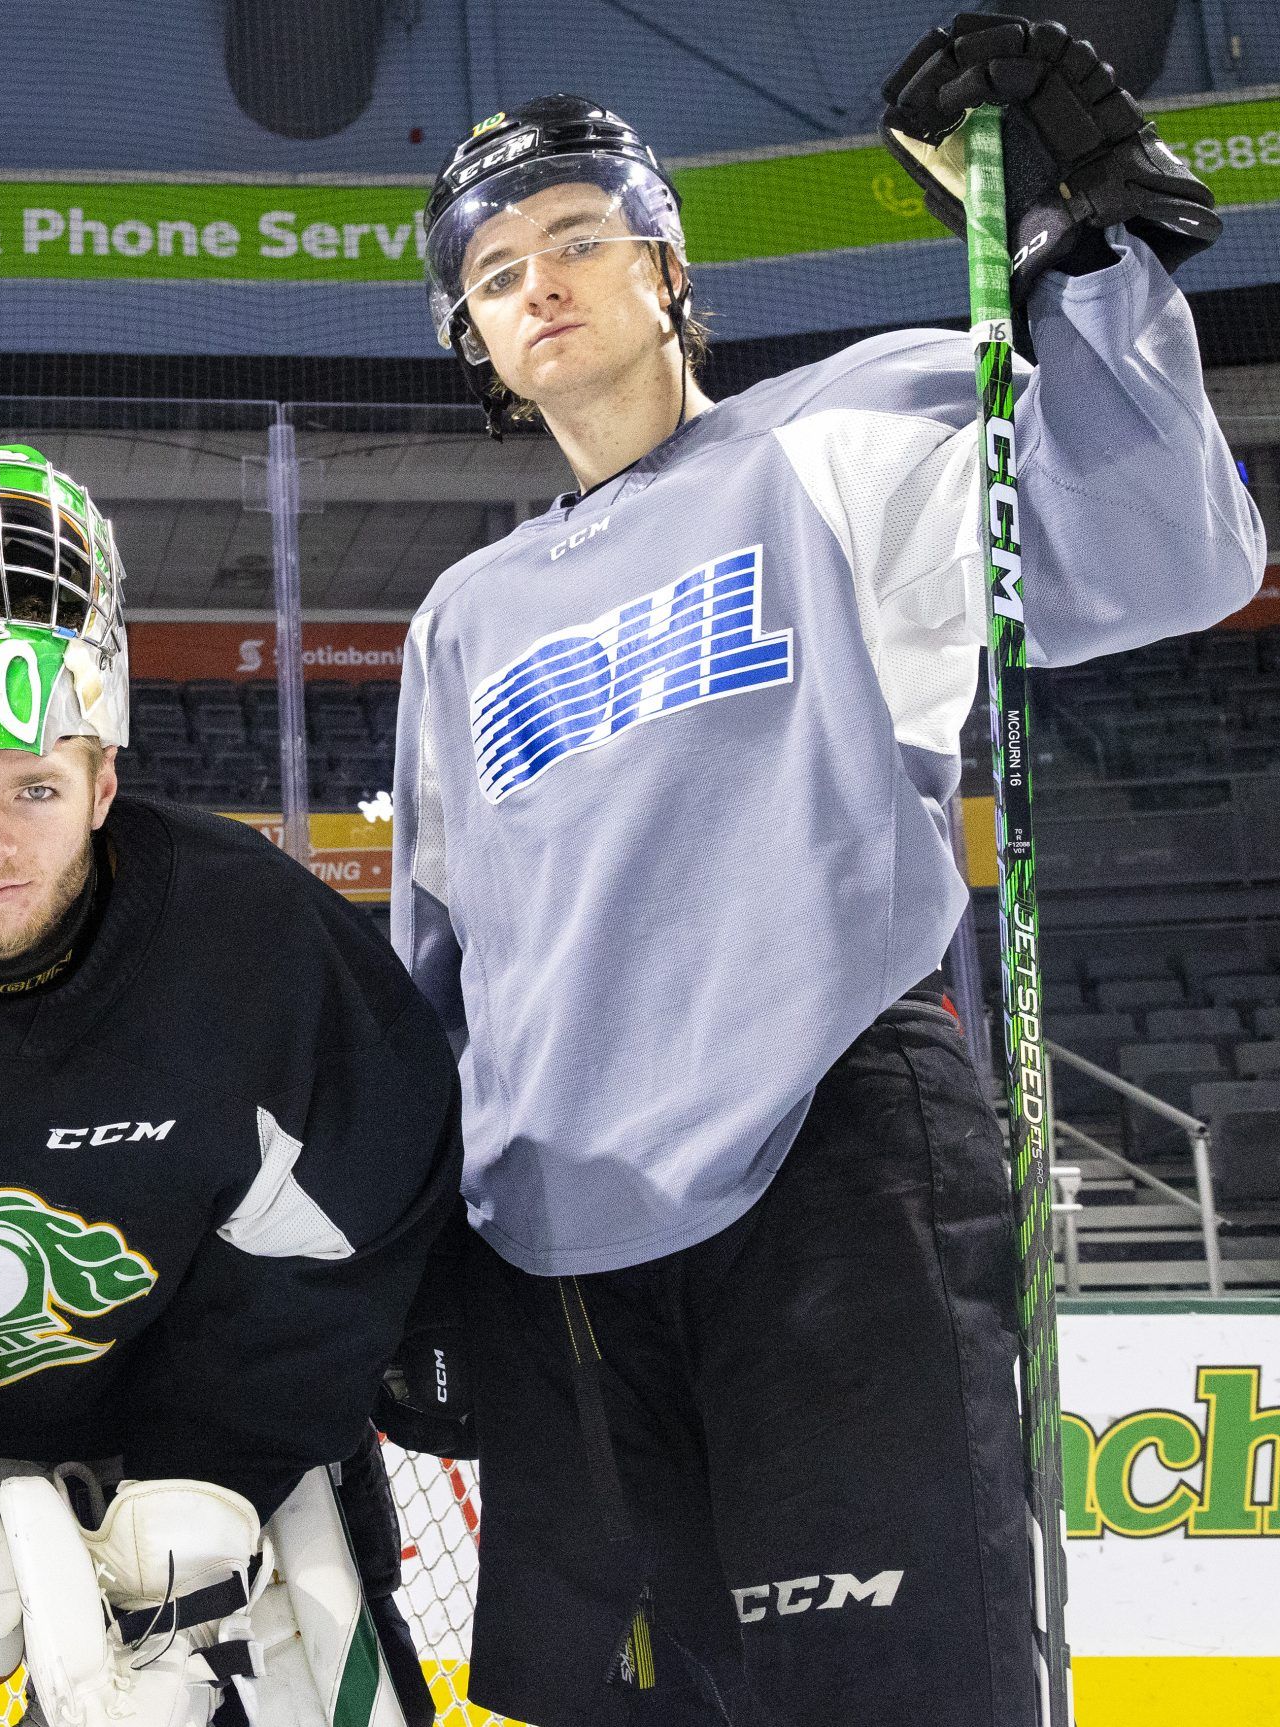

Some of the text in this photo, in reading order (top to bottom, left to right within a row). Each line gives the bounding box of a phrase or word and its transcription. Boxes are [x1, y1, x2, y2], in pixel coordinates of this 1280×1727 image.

[22, 206, 248, 259] Phone
[1010, 230, 1048, 277] CC
[989, 322, 1006, 341] 16
[549, 516, 611, 562] CCM
[985, 415, 1025, 623] CCM
[1007, 710, 1022, 787] MCGURN 16
[1013, 902, 1045, 1125] JETSPEED
[45, 1119, 177, 1150] CCM
[433, 1348, 448, 1403] CCM
[730, 1569, 905, 1625] CCM
